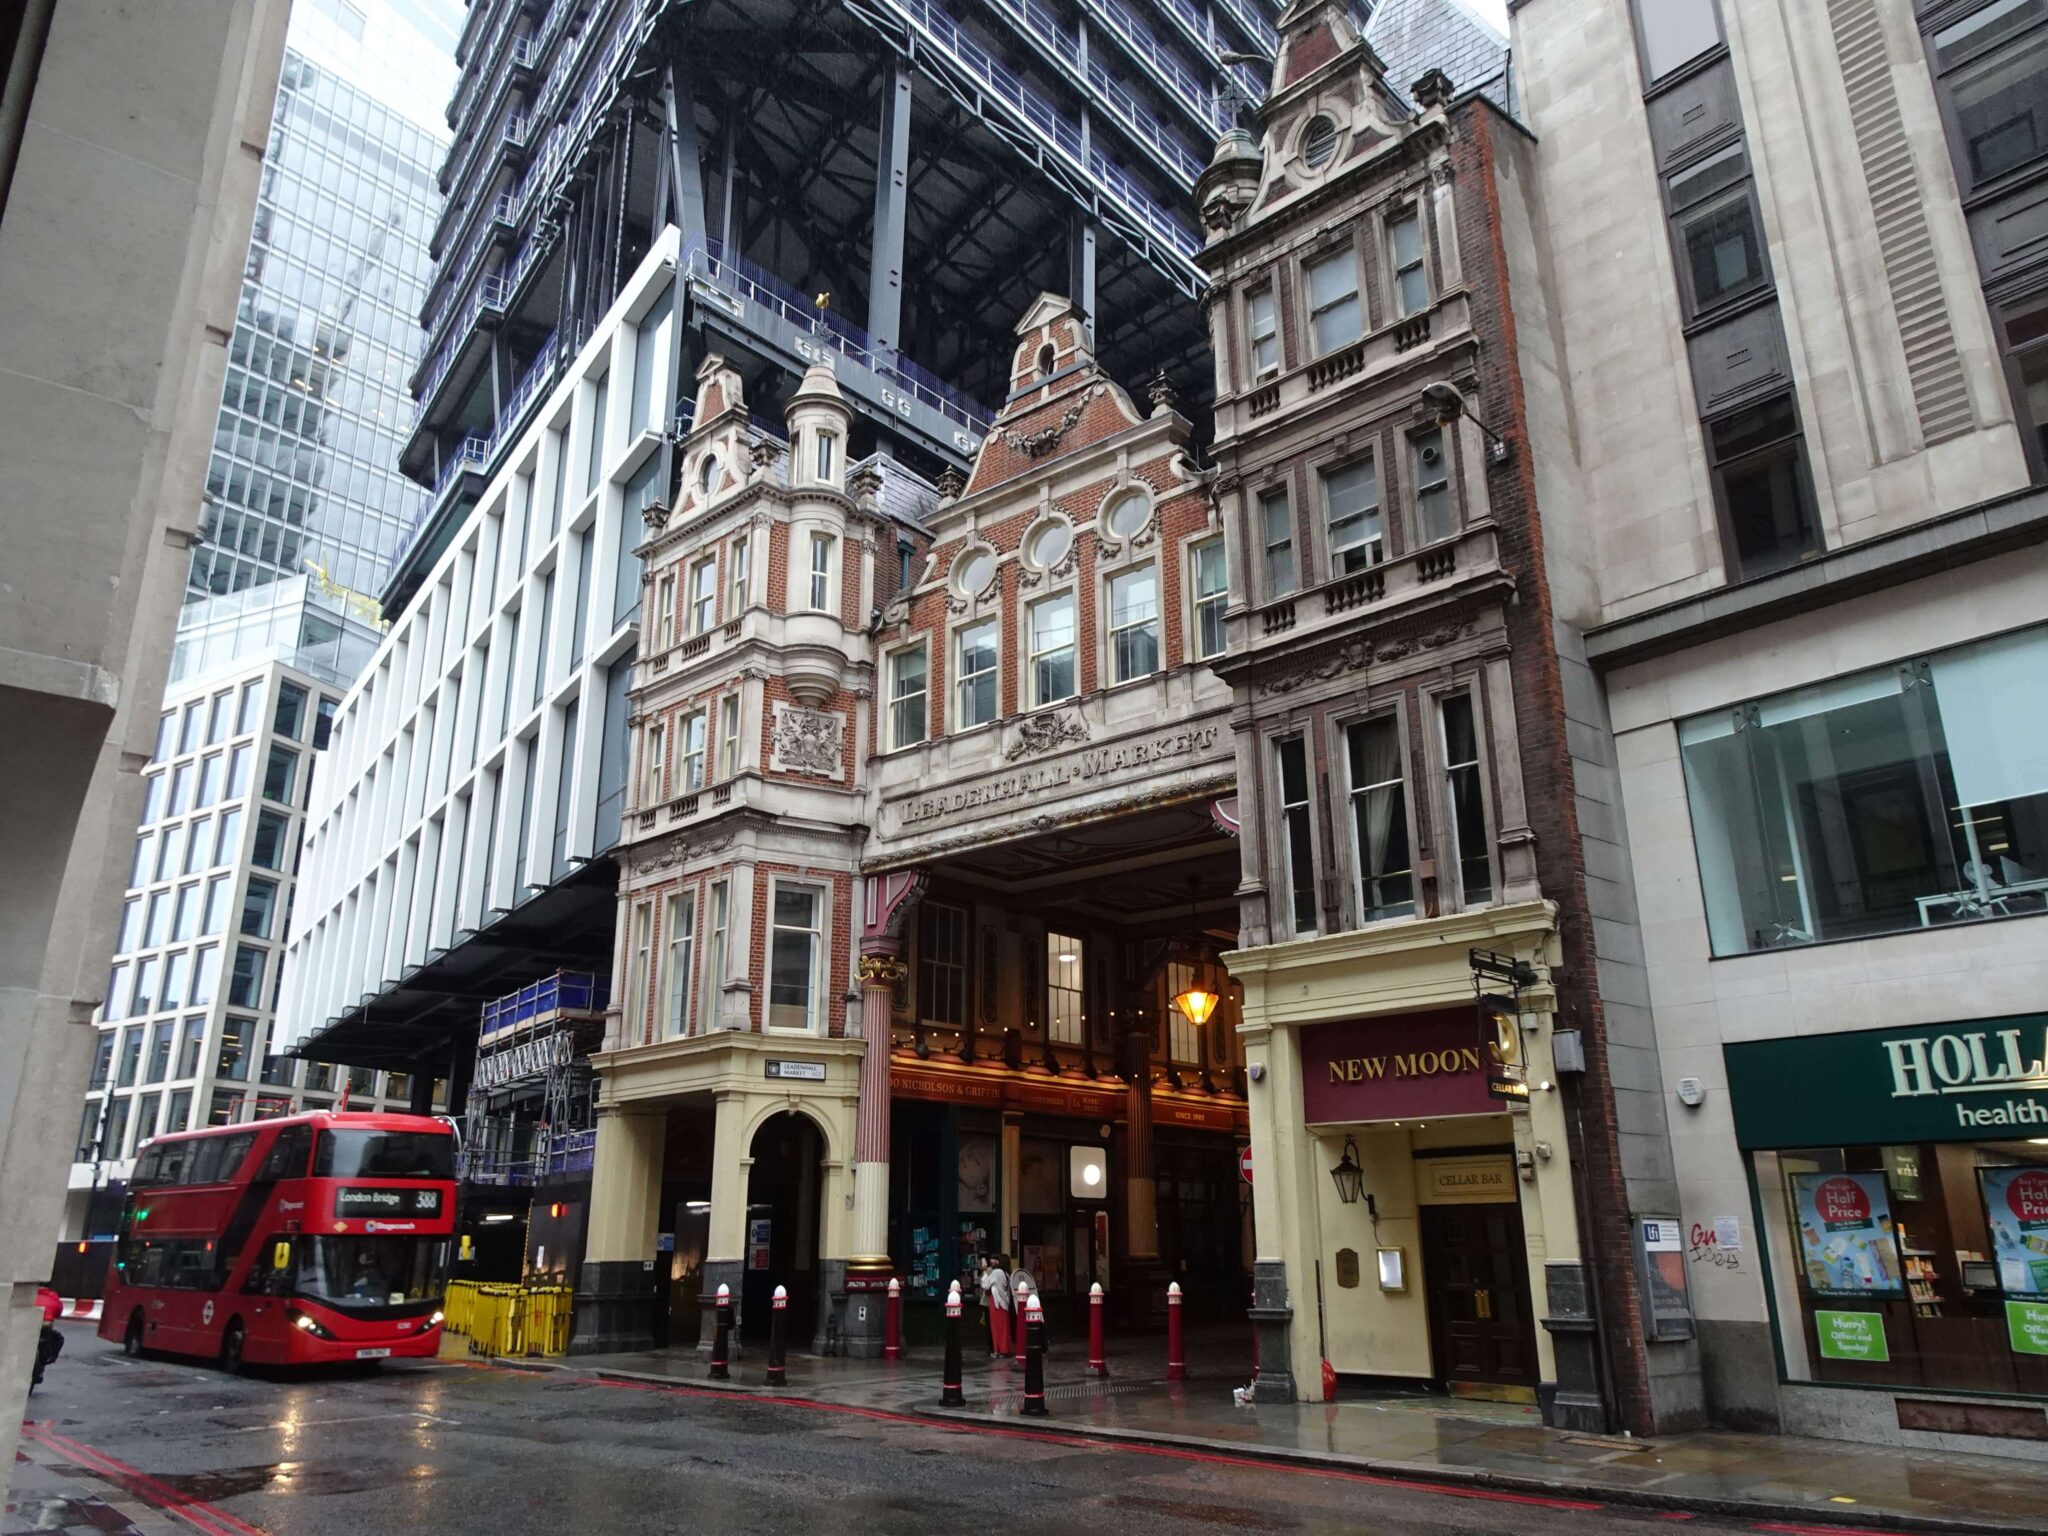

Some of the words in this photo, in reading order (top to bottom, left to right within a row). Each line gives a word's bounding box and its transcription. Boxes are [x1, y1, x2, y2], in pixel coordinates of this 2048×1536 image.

[902, 764, 1071, 825] LEADENHALL
[1082, 726, 1217, 780] MARKET
[784, 1063, 817, 1071] LEADENHALL
[1329, 1056, 1387, 1083] NEW
[1394, 1047, 1480, 1077] MOON
[902, 1079, 955, 1094] NICHOLSON
[957, 1085, 964, 1095] &
[1440, 1174, 1479, 1186] CELLAR
[1481, 1173, 1503, 1185] BAR
[340, 1190, 371, 1202] London
[372, 1192, 400, 1205] Bridge
[416, 1191, 437, 1208] 388
[1826, 1191, 1857, 1205] Half
[1828, 1205, 1862, 1218] Price
[1832, 1318, 1867, 1332] Hurry!
